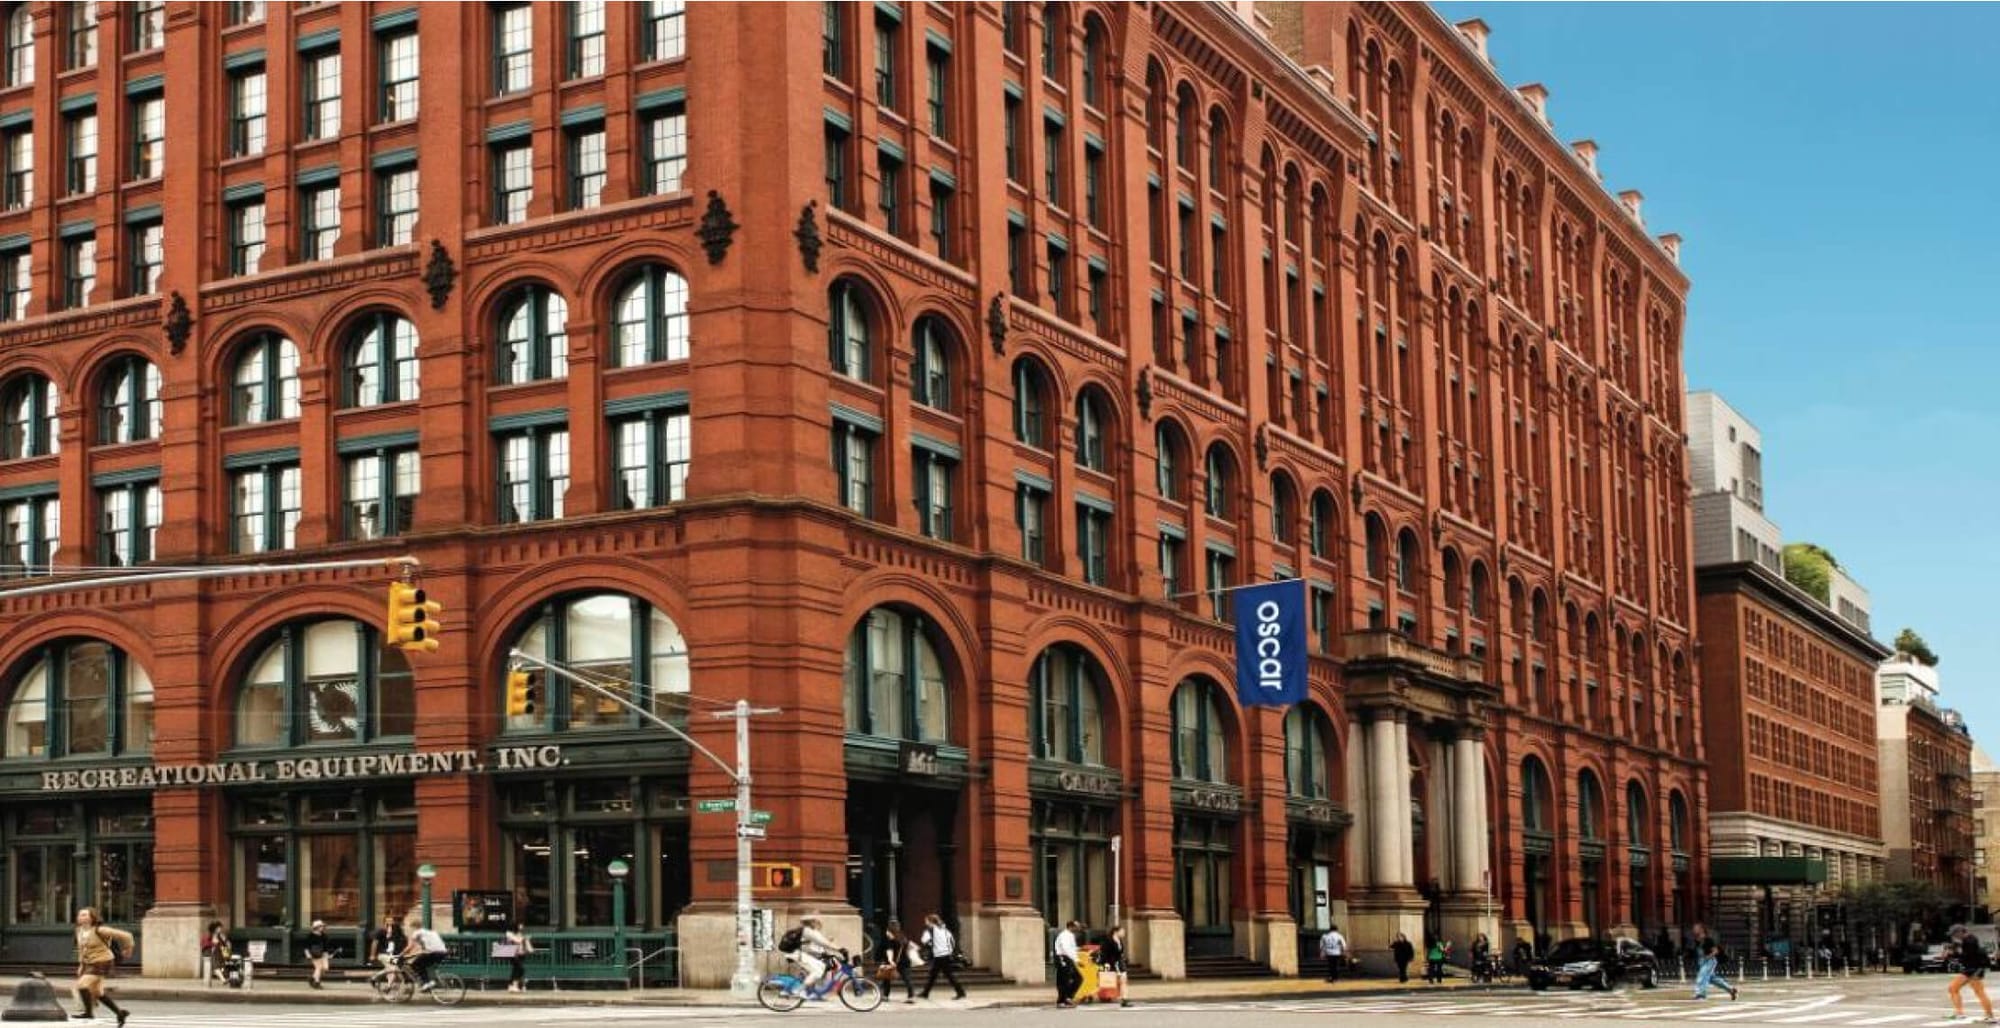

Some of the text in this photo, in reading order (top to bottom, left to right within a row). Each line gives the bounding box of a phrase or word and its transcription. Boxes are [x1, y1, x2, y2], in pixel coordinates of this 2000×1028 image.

[1257, 600, 1282, 691] oscar
[41, 745, 570, 790] RECREATIONAL EQUIPMENT, INC.
